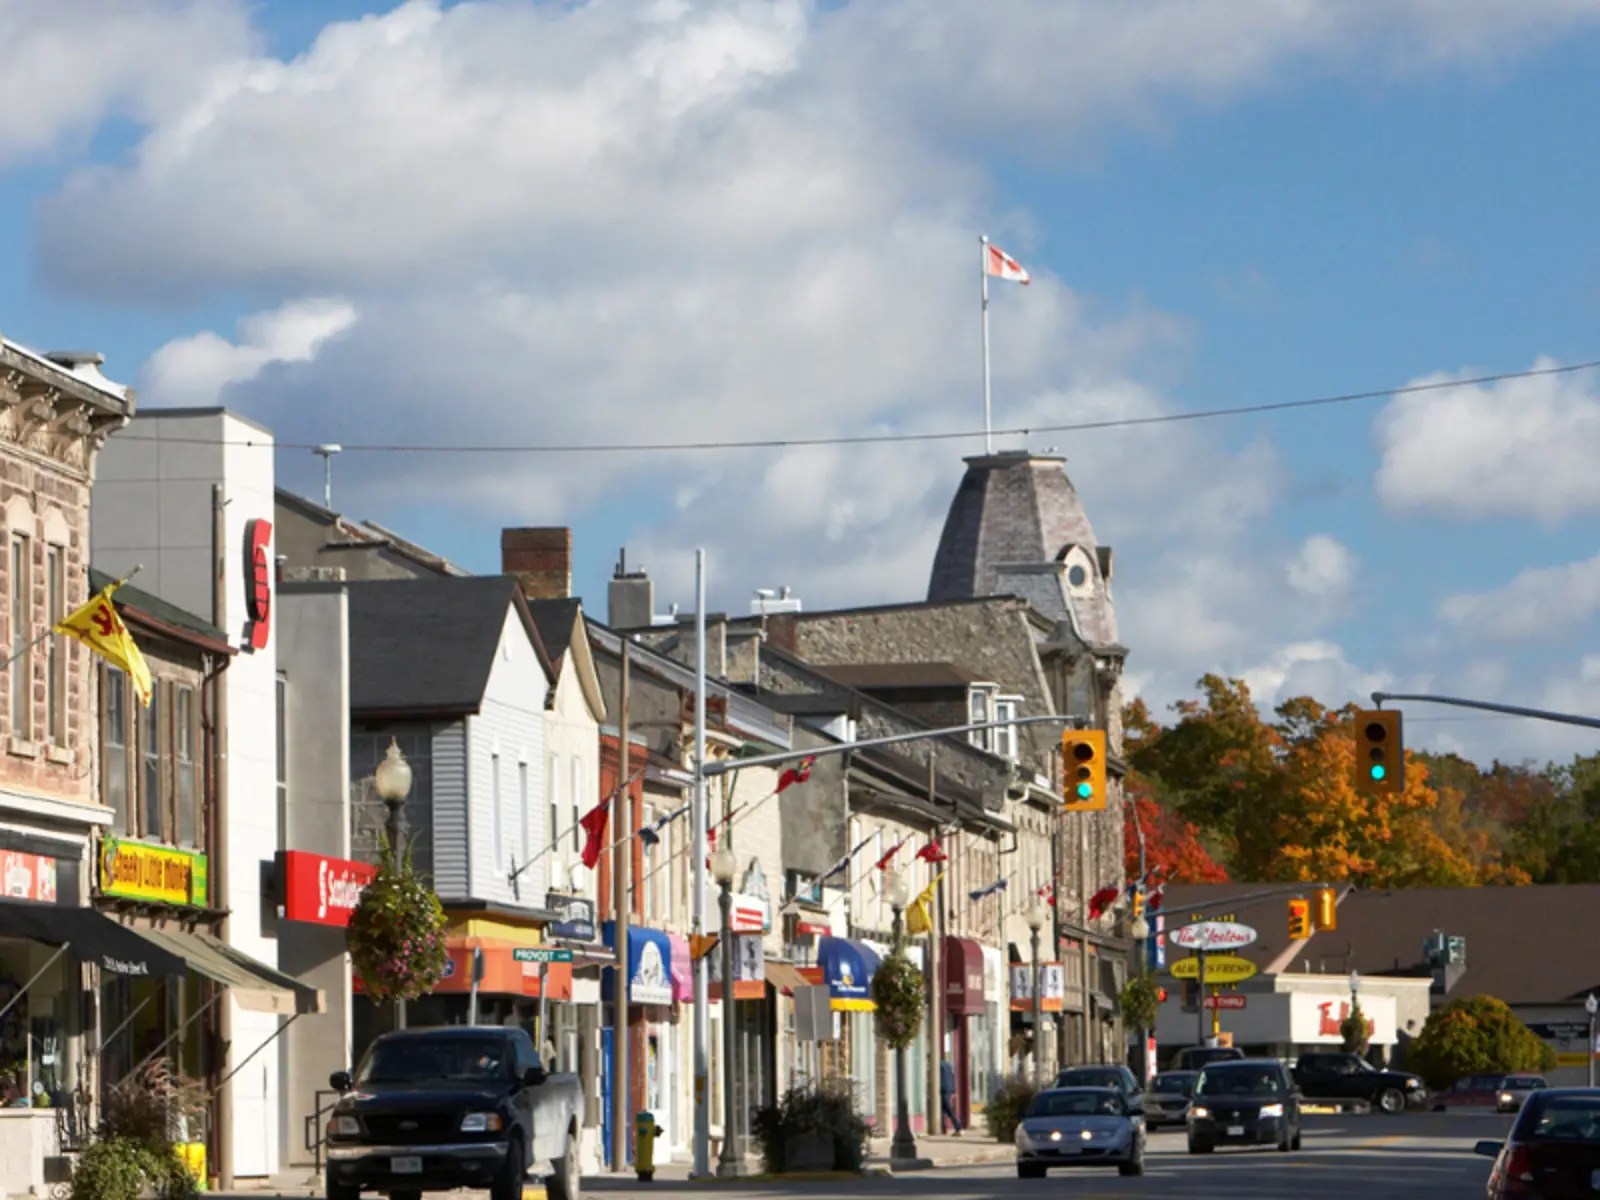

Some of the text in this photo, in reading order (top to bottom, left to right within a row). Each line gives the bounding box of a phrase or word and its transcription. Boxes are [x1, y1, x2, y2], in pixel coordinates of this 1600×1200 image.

[515, 949, 553, 961] PROVOST
[1175, 963, 1251, 973] ALWS FRESH
